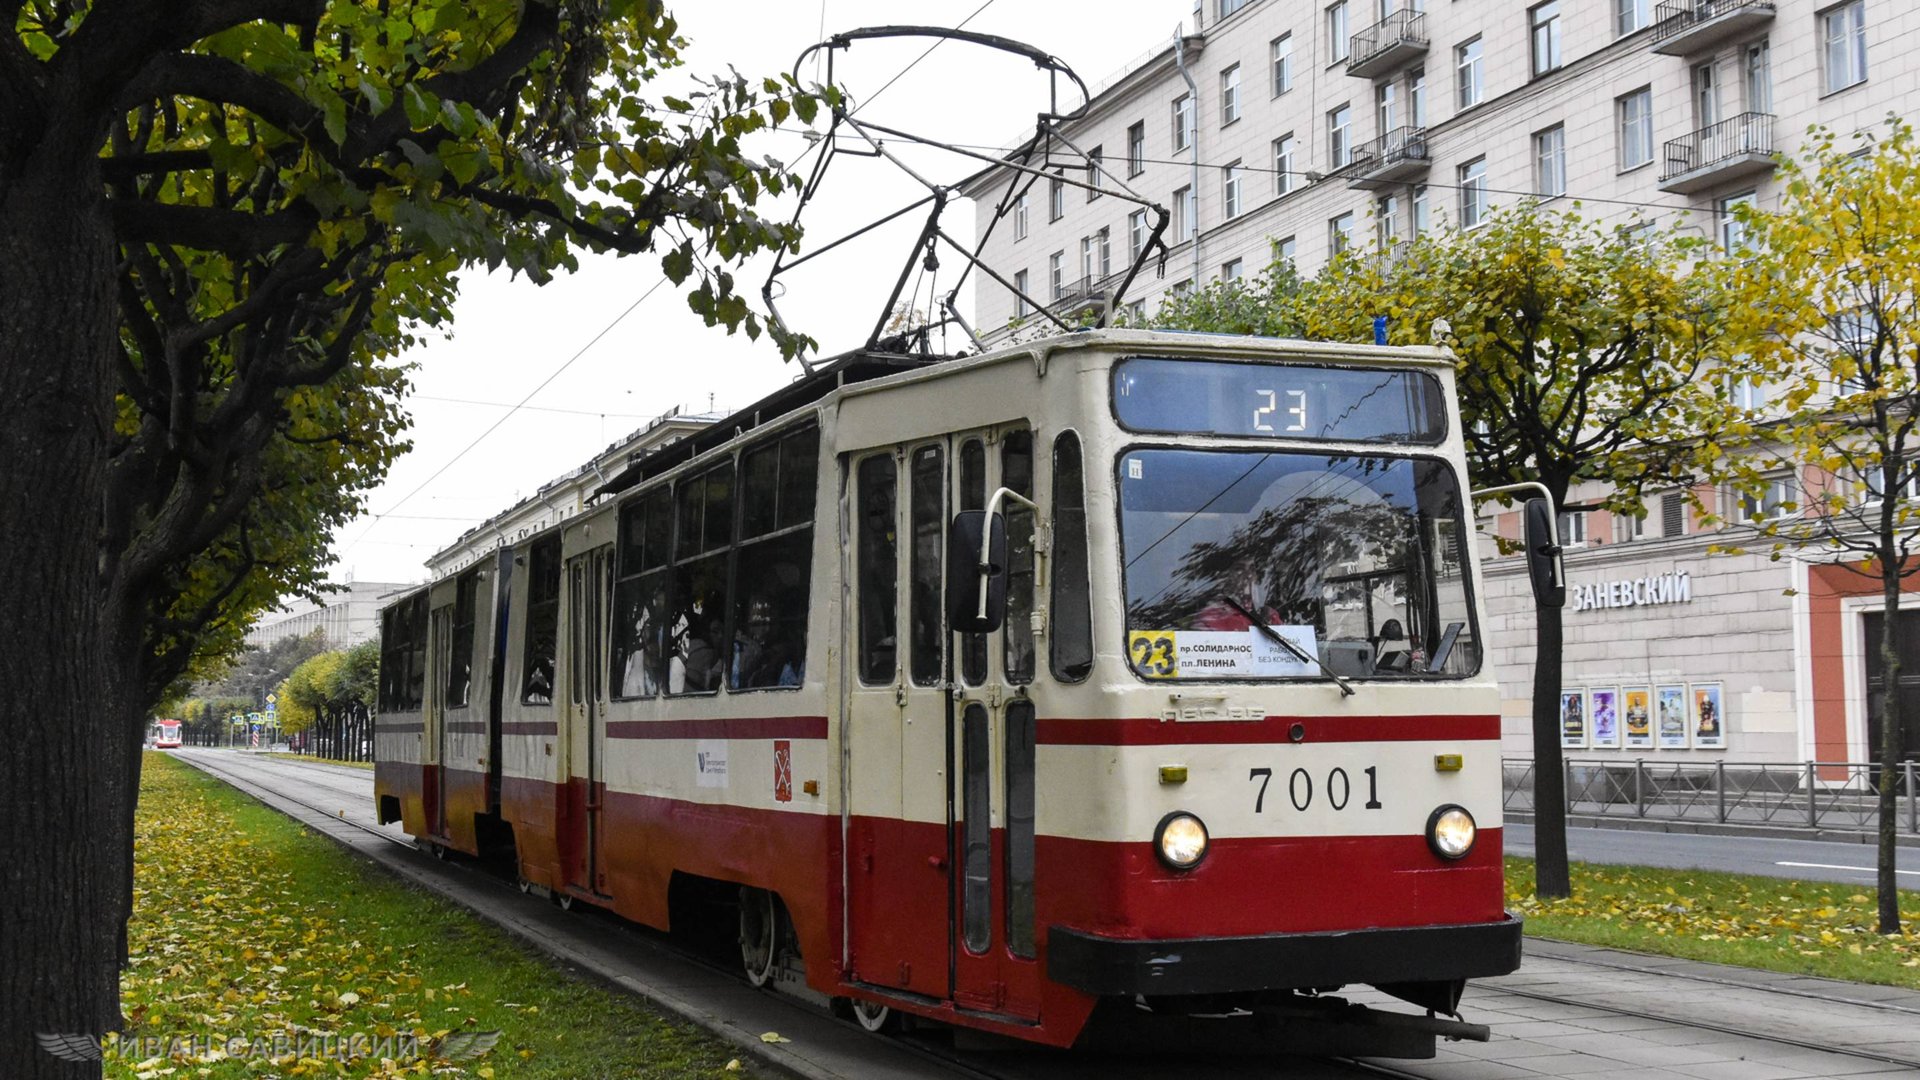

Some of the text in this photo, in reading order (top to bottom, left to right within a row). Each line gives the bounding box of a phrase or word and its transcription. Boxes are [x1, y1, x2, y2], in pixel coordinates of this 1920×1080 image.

[1253, 389, 1306, 431] 23
[1572, 569, 1691, 611] ЗАНЕВСКИЙ
[1132, 637, 1176, 676] 23
[1249, 765, 1383, 813] 7001
